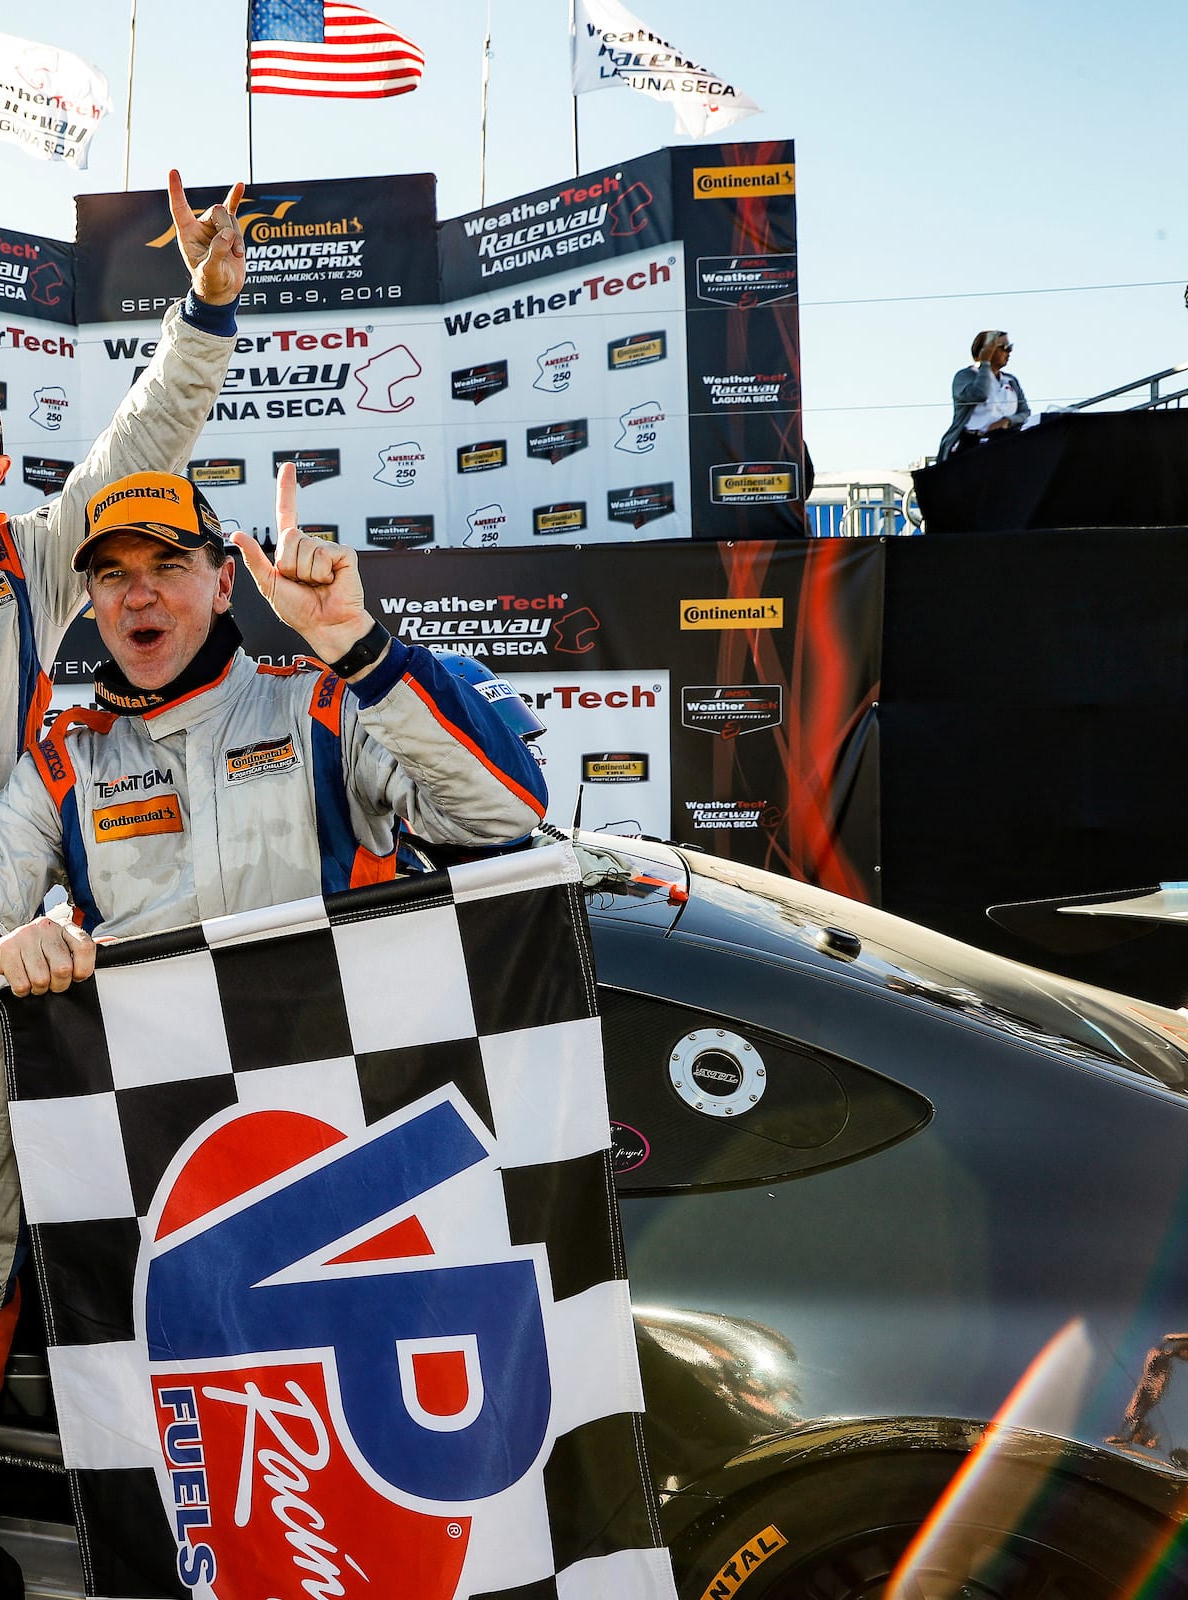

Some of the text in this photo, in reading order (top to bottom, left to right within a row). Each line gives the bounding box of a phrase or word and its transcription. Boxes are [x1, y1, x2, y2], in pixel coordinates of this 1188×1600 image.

[681, 80, 737, 97] SECA
[697, 172, 780, 192] Continental
[464, 175, 619, 238] WeatherTech
[251, 218, 347, 243] Continental
[478, 202, 609, 258] Raceway
[245, 239, 365, 260] MONTEREY
[481, 230, 606, 278] LAGUNA SECA
[245, 254, 363, 272] GRAND PRIX
[245, 275, 282, 284] ATURING
[327, 270, 345, 280] TIRE
[346, 269, 363, 279] 250
[702, 269, 795, 283] WeatherTech
[121, 285, 402, 313] SEPTER 8-9, 2018
[444, 261, 671, 337] WeatherTech
[103, 326, 369, 360] WeerTech
[552, 371, 571, 383] 250
[702, 373, 786, 385] WeatherTech
[711, 384, 781, 397] Raceway
[712, 395, 779, 404] LAGUNA SECA
[46, 412, 62, 422] 250
[266, 397, 346, 418] SECA
[636, 432, 656, 444] 250
[396, 468, 416, 478] 250
[93, 486, 166, 524] Continental
[481, 532, 499, 543] 250
[380, 594, 565, 615] WeatherTech
[684, 606, 765, 624] Continental
[398, 616, 552, 641] Raceway
[492, 641, 548, 656] SECA
[94, 681, 149, 709] tinental
[518, 685, 656, 710] erTech
[686, 702, 777, 712] WeatherTech
[231, 748, 282, 769] Continental
[685, 801, 766, 810] WeatherTech
[693, 810, 760, 821] Raceway
[98, 809, 164, 831] Continental
[694, 820, 758, 829] LAGUNA SECA
[158, 1386, 217, 1588] FUELS
[201, 1379, 372, 1600] Racin
